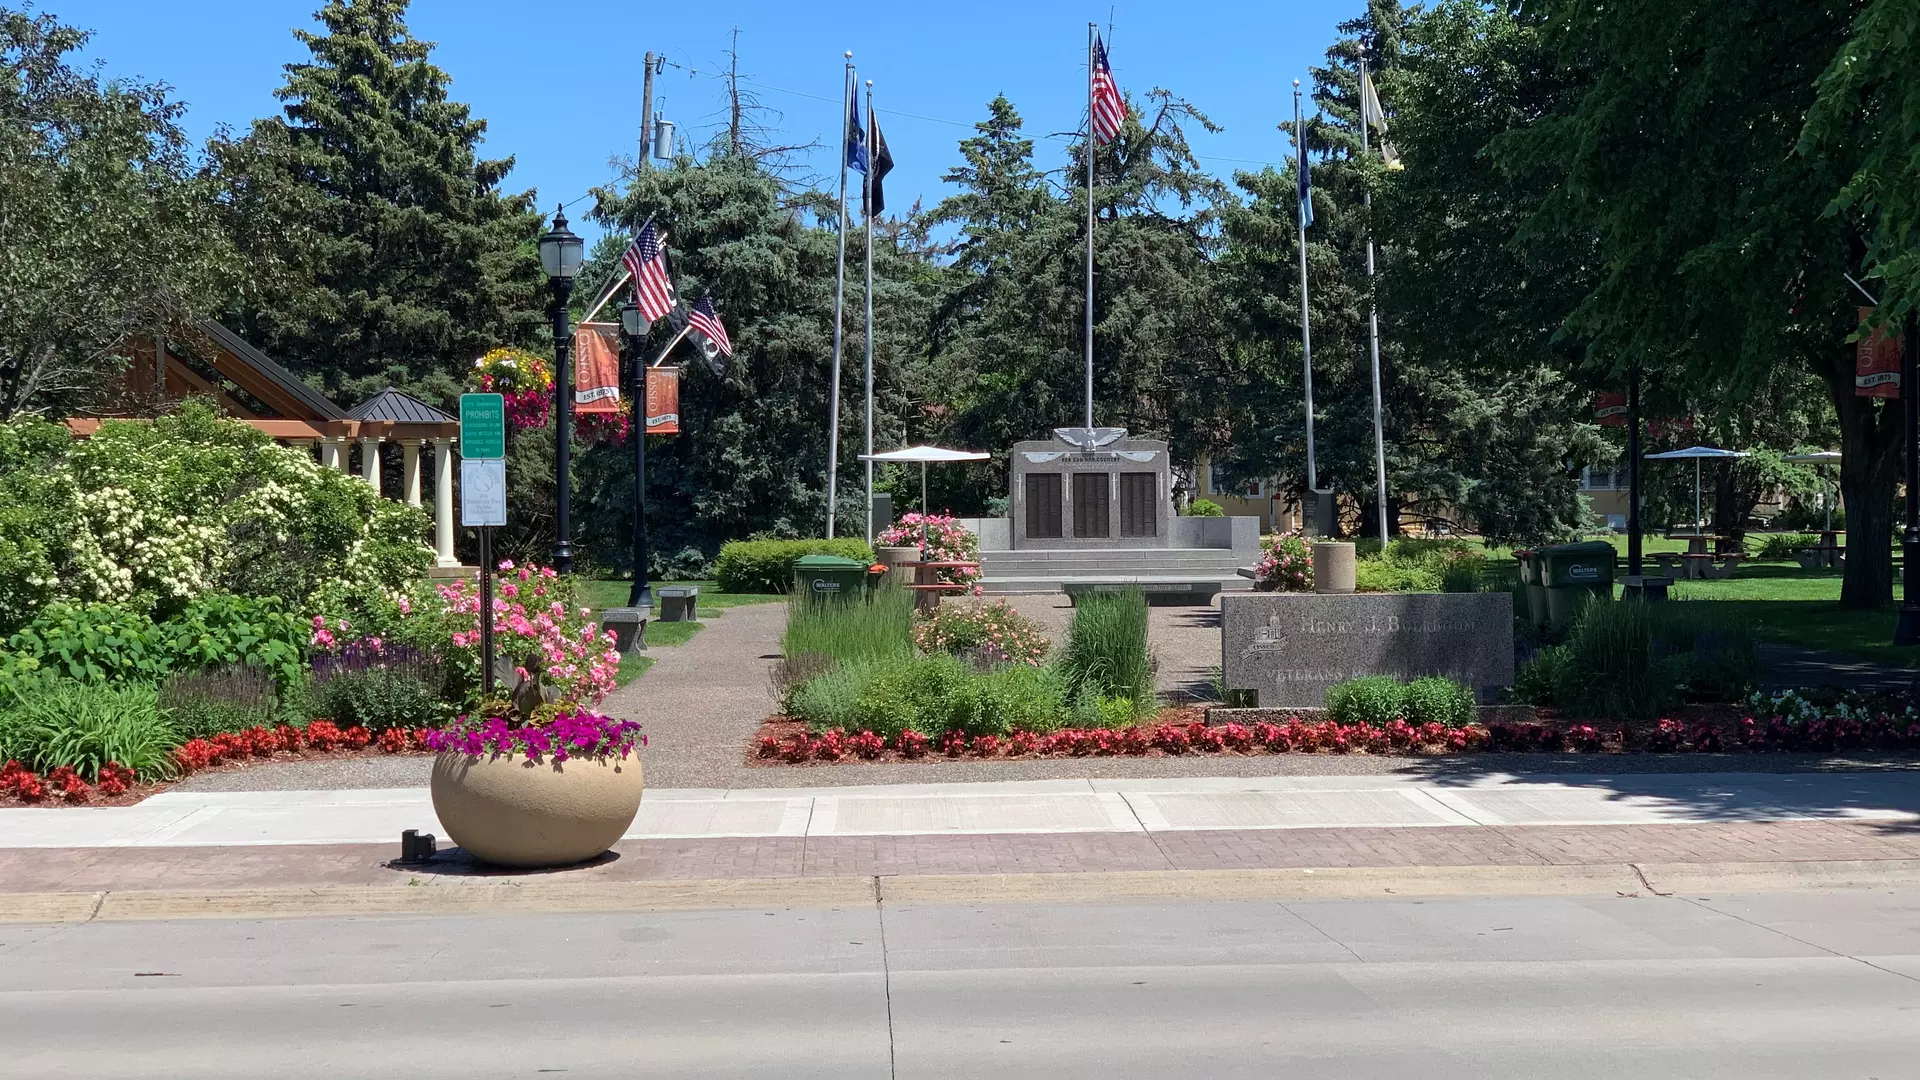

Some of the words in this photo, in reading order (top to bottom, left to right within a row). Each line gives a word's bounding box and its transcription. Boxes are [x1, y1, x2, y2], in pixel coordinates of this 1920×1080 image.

[578, 333, 591, 383] OSSEO
[1864, 376, 1877, 385] EST.
[1877, 374, 1891, 382] 1875
[583, 391, 596, 400] EST.
[596, 388, 610, 397] 1875
[649, 375, 658, 412] OSSEO
[465, 410, 500, 419] PROHIBITS
[1301, 616, 1354, 633] HENRY
[1365, 615, 1381, 633] J.
